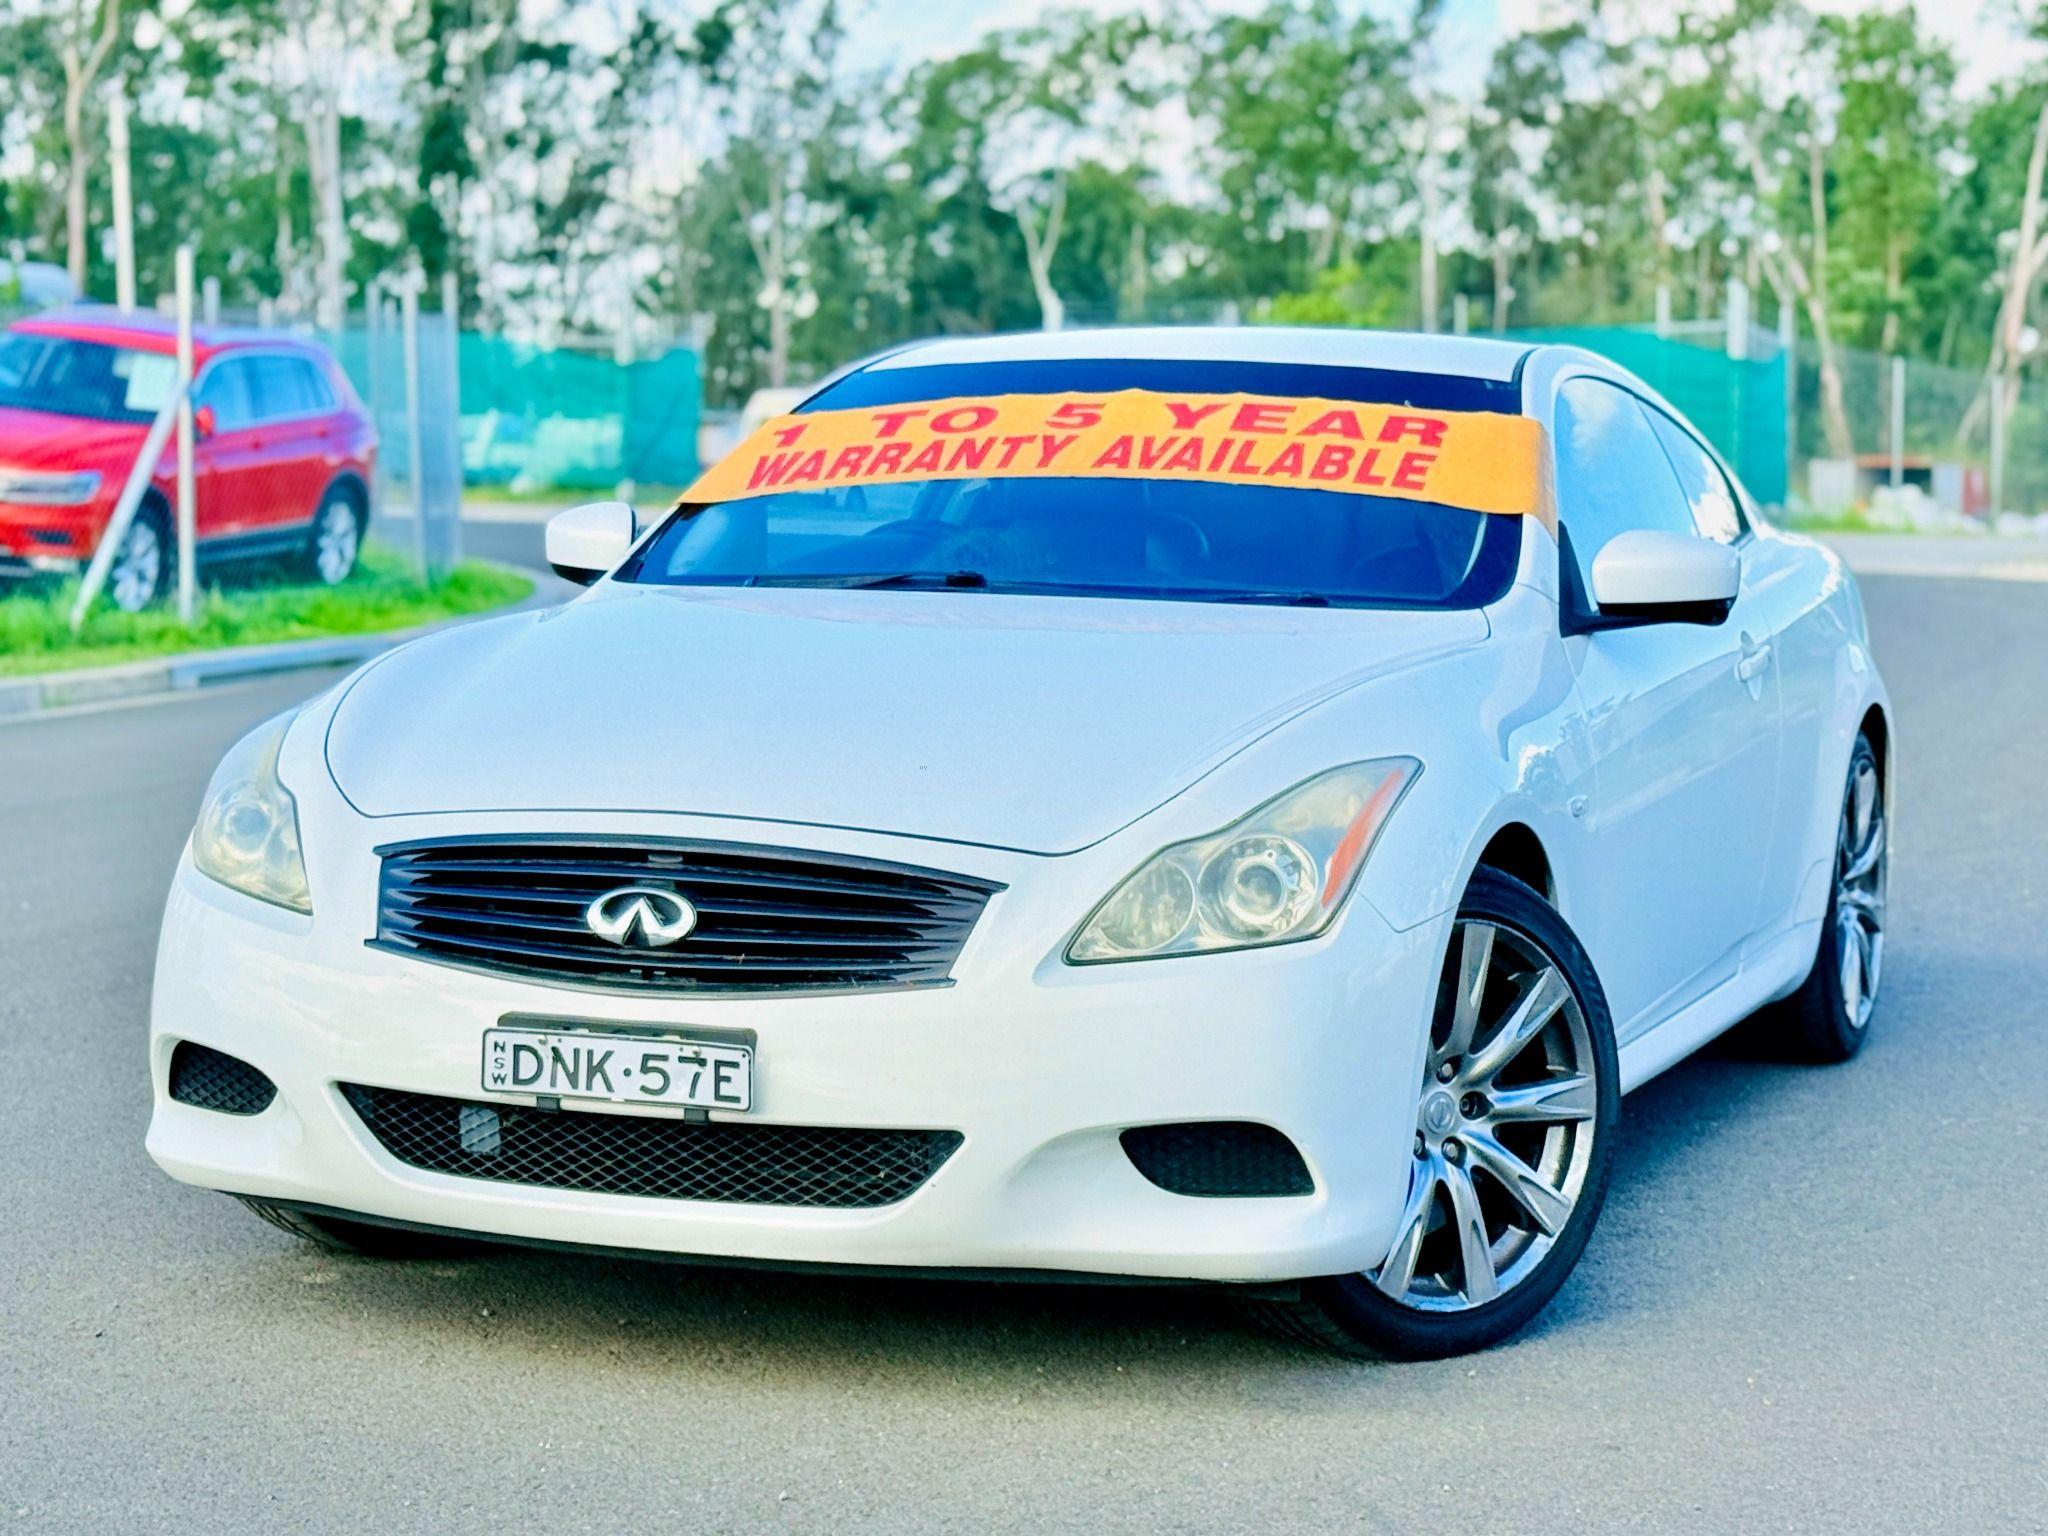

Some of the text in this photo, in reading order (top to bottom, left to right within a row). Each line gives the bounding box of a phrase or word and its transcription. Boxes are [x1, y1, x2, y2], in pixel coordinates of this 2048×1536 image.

[774, 403, 1449, 447] 1 TO 5 YEAR
[747, 434, 1437, 490] WARRANTY AVAILABLE
